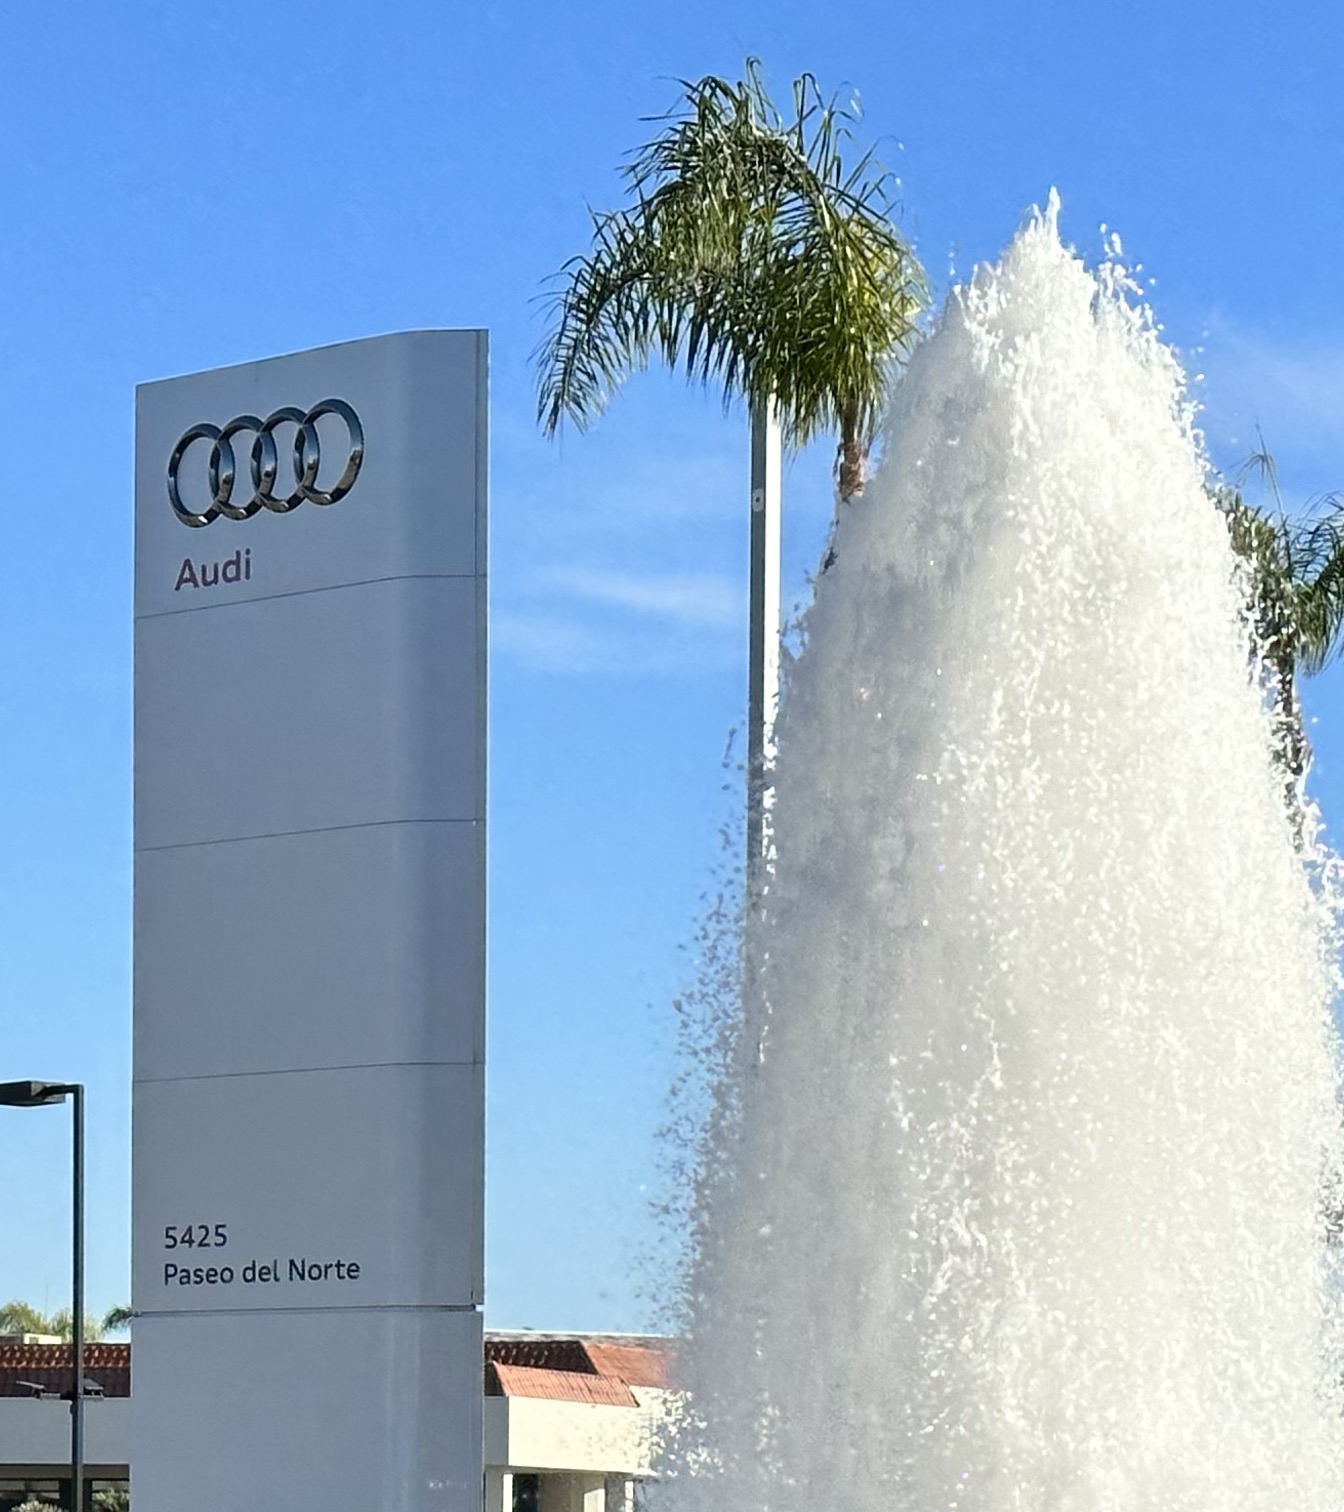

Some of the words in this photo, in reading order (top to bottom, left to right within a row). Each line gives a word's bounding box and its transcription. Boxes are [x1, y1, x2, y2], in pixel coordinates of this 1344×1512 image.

[174, 547, 252, 591] Audi
[164, 1224, 228, 1249] 5425
[164, 1262, 234, 1286] Paseo
[241, 1259, 280, 1283] del
[288, 1258, 361, 1282] Norte
